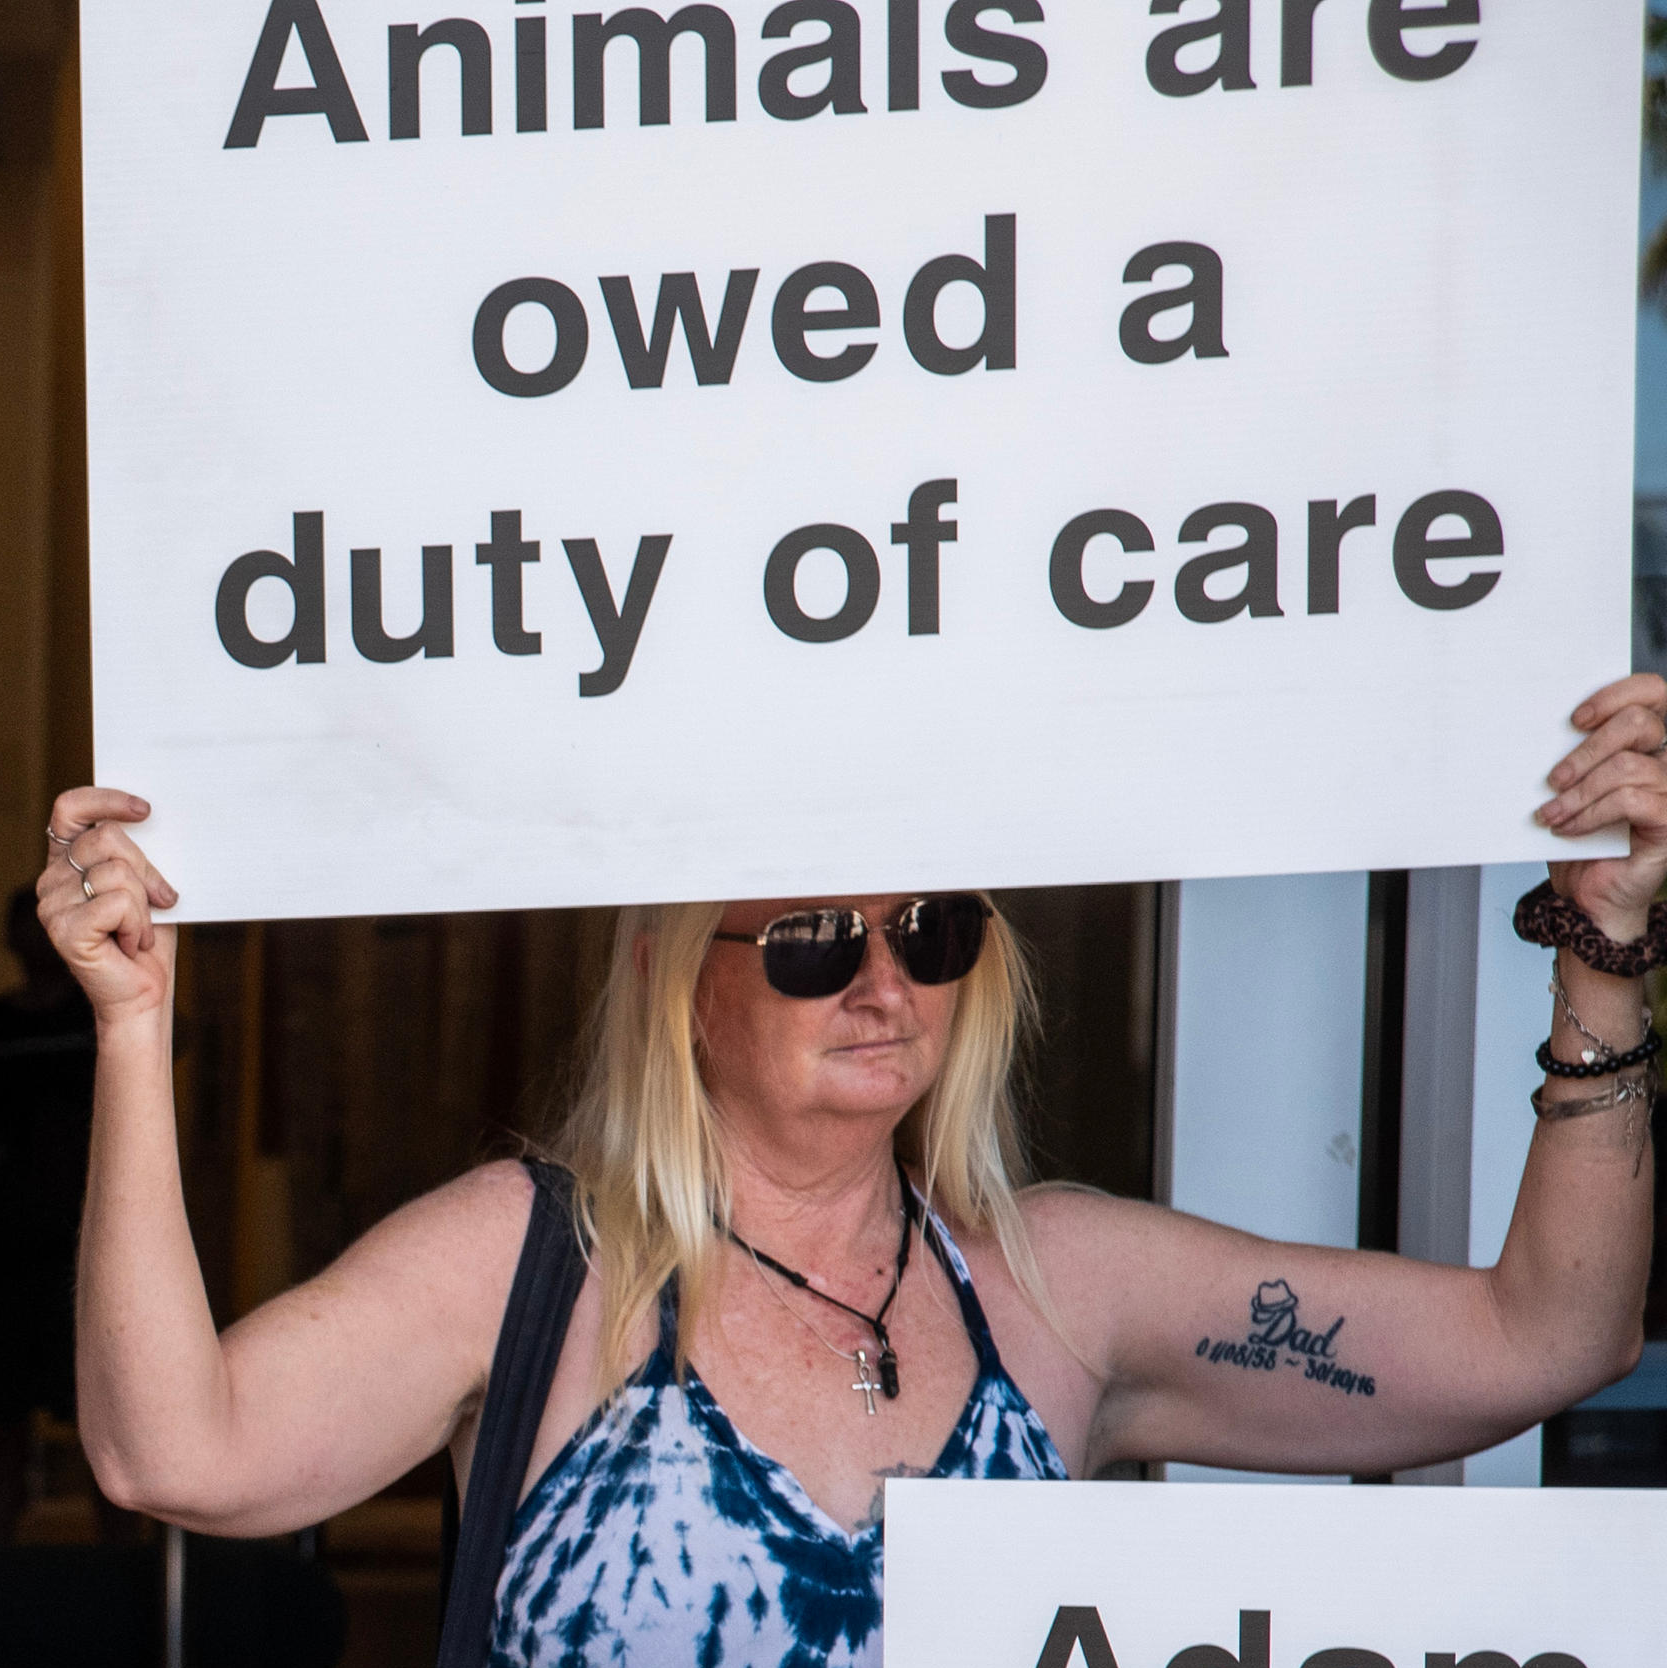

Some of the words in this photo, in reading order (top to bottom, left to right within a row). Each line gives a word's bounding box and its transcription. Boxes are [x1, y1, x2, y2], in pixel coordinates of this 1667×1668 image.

[222, 0, 1048, 149] Animals
[1145, 0, 1481, 98] are
[472, 213, 1017, 398] owed
[1118, 241, 1230, 365] a
[215, 509, 673, 698] duty
[763, 478, 958, 644] of
[1049, 489, 1505, 630] care
[1248, 1307, 1345, 1359] Dad
